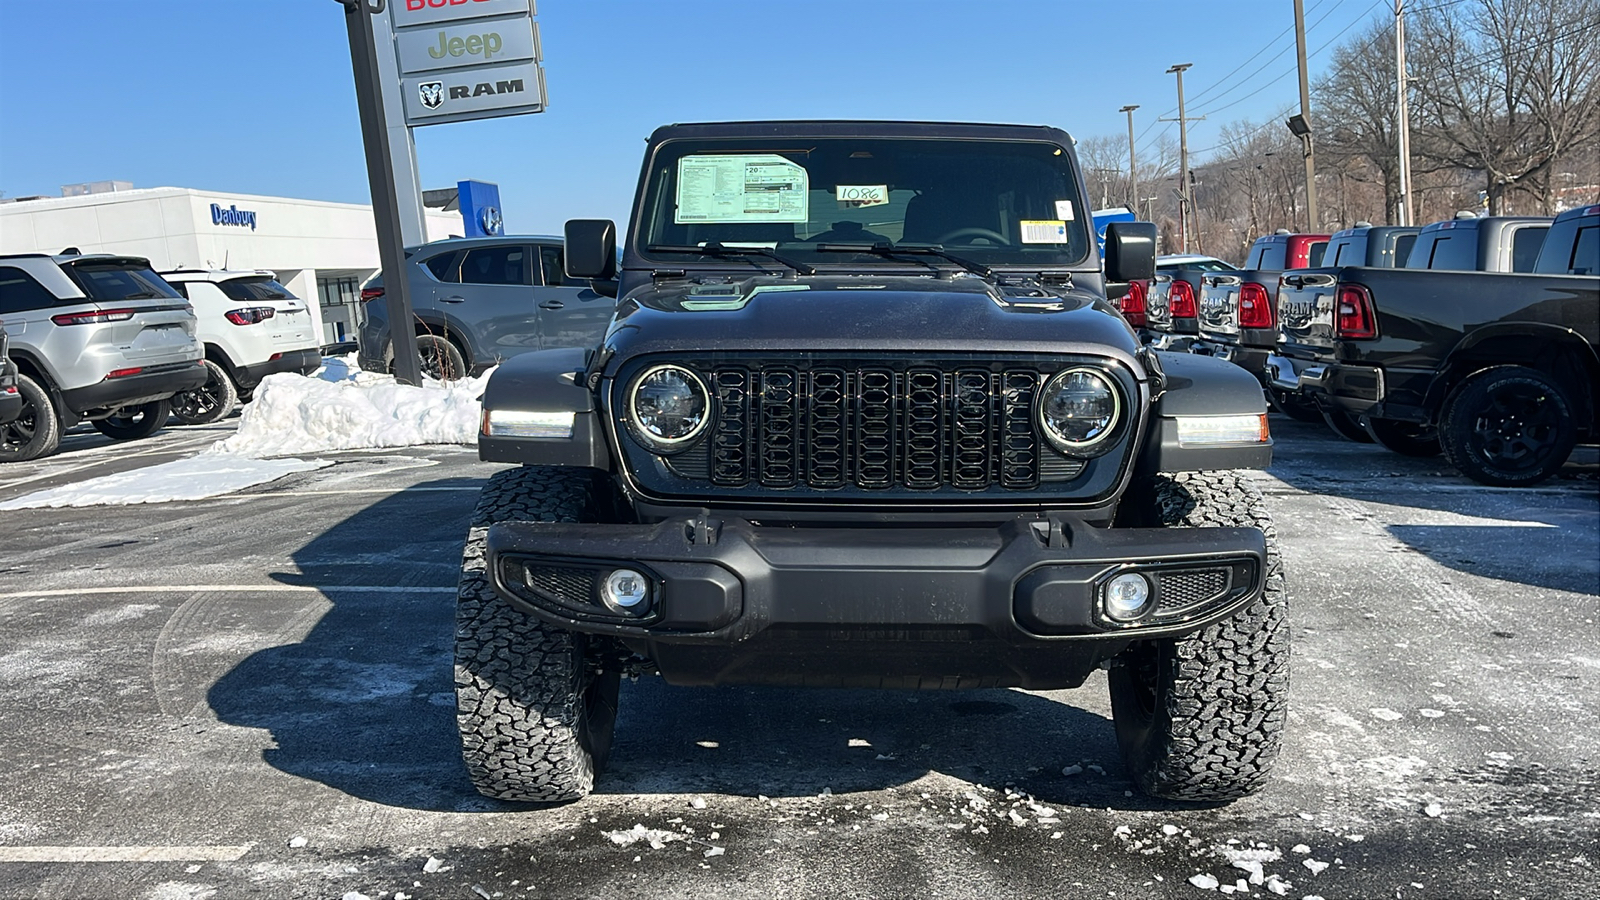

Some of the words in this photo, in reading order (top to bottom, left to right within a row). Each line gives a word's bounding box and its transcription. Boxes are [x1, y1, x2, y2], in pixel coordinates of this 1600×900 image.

[428, 31, 502, 59] Jeep
[449, 79, 524, 100] RAM
[842, 188, 879, 199] 1086
[210, 203, 256, 232] Danbury
[1284, 302, 1312, 315] RAM
